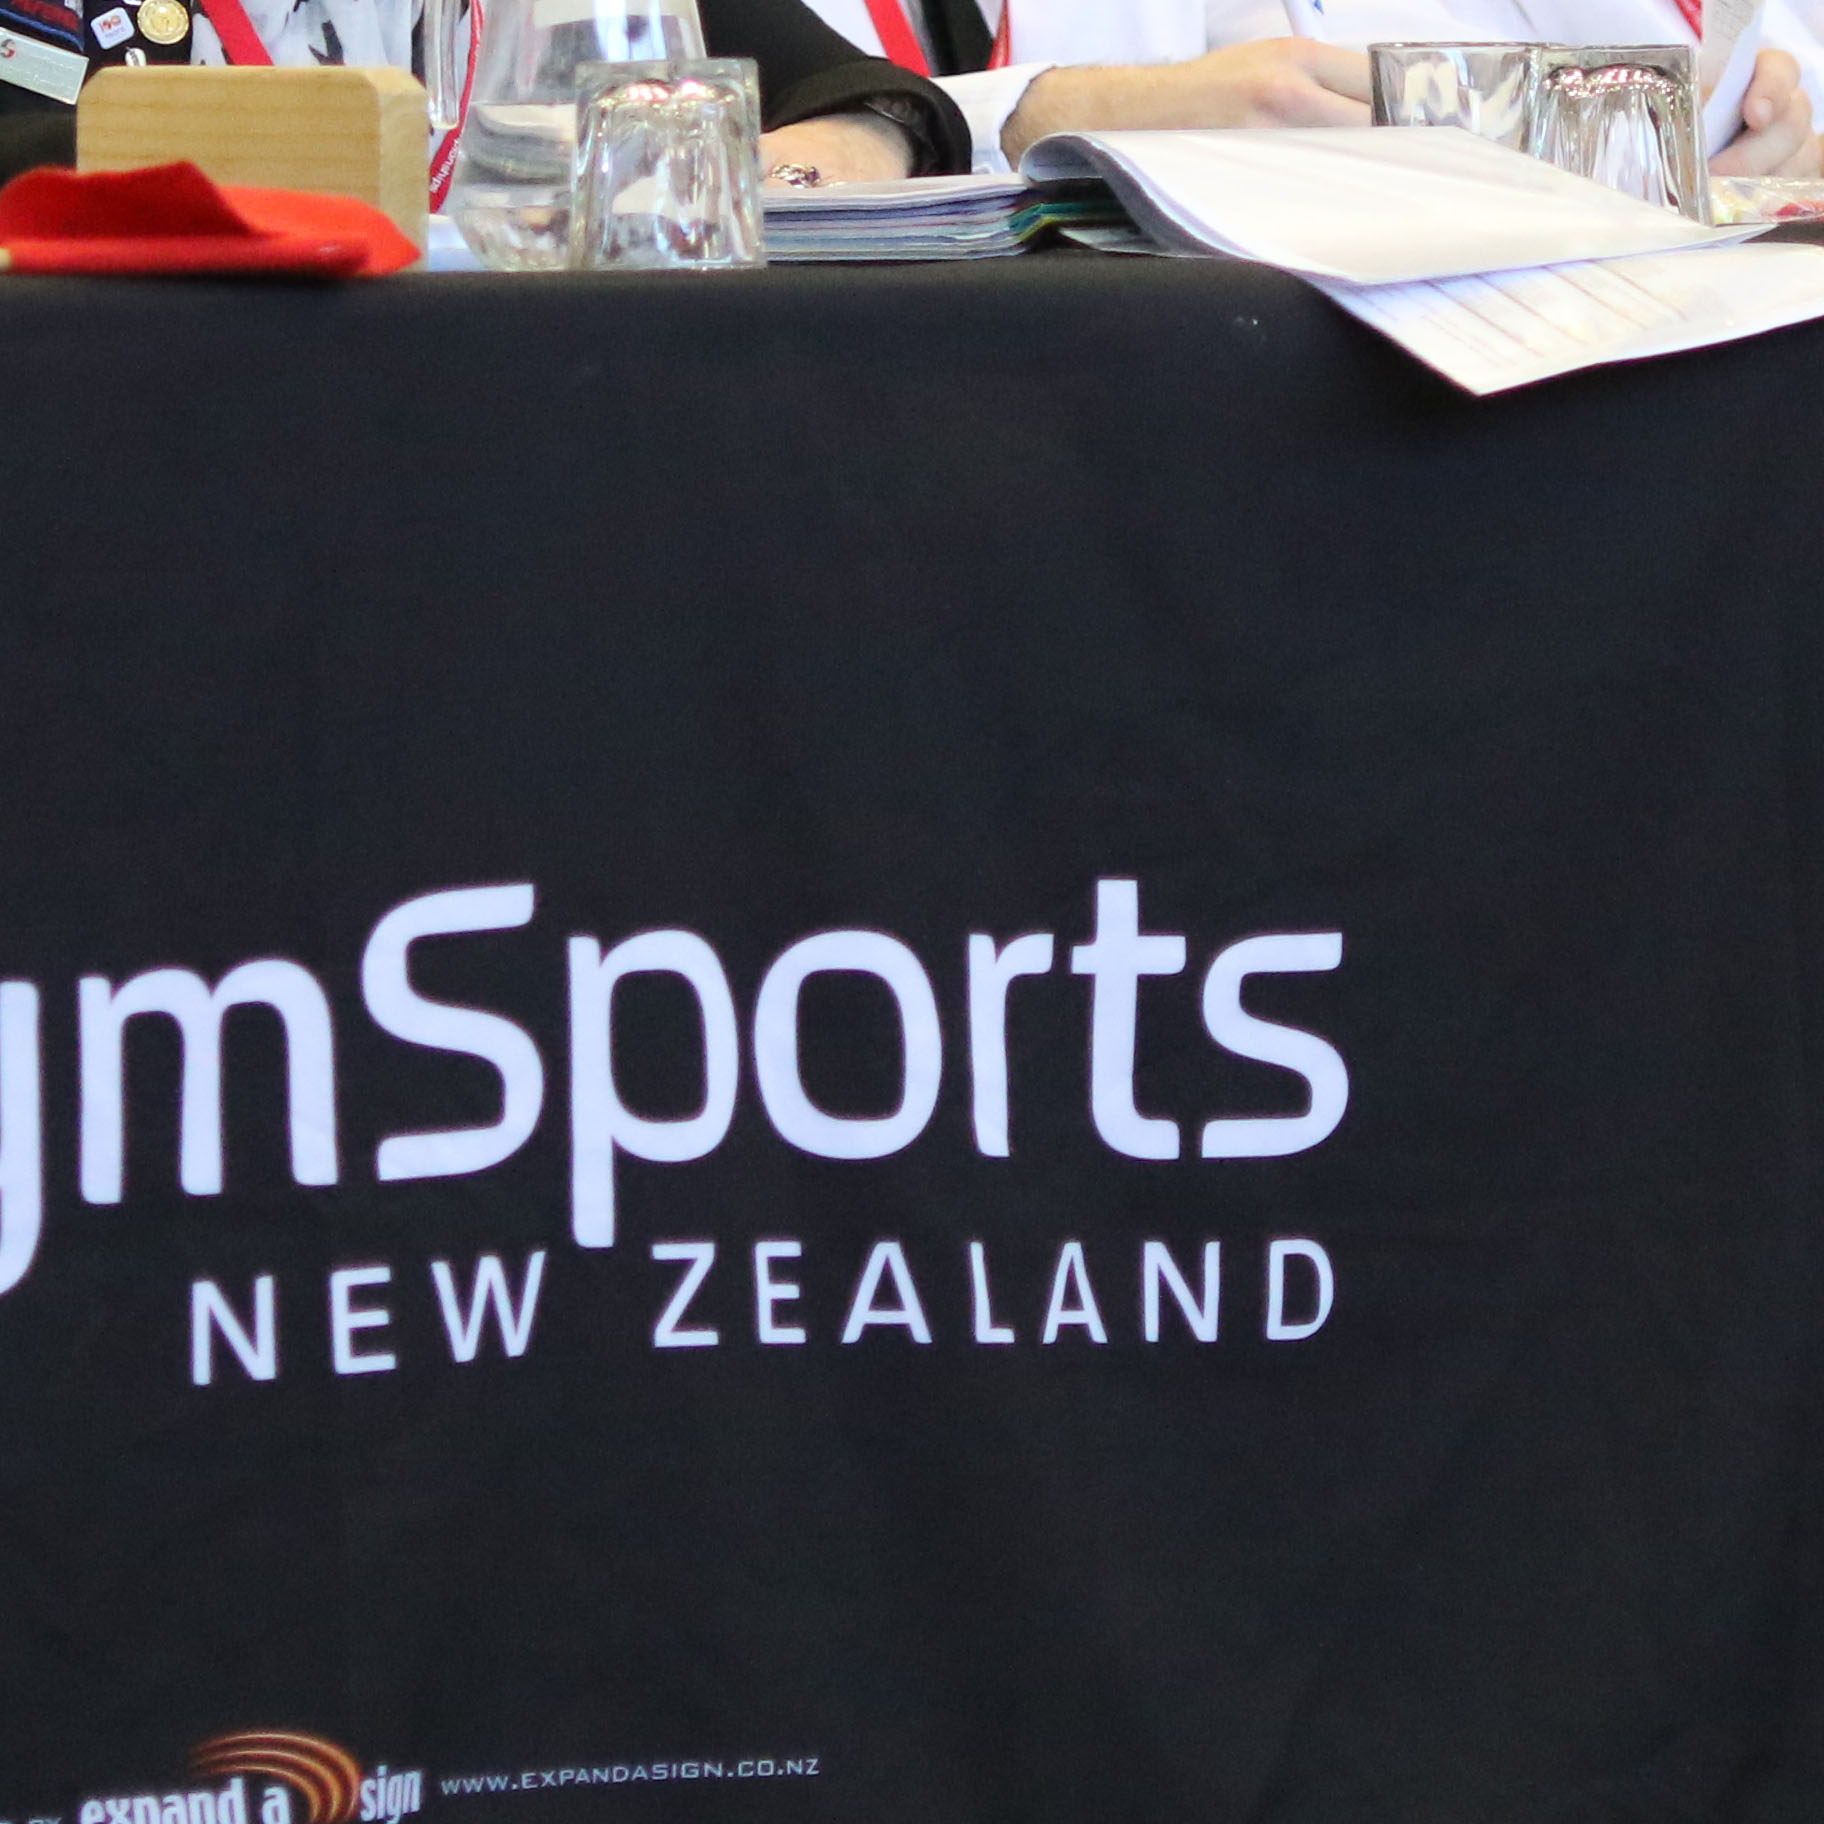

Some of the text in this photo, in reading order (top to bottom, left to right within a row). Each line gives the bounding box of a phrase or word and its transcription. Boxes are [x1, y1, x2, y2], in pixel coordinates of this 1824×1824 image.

[192, 1239, 1334, 1385] NEW ZEALAND
[359, 1765, 424, 1824] sign
[441, 1758, 821, 1797] WWW.EXPANDASIGN.CO.NZ
